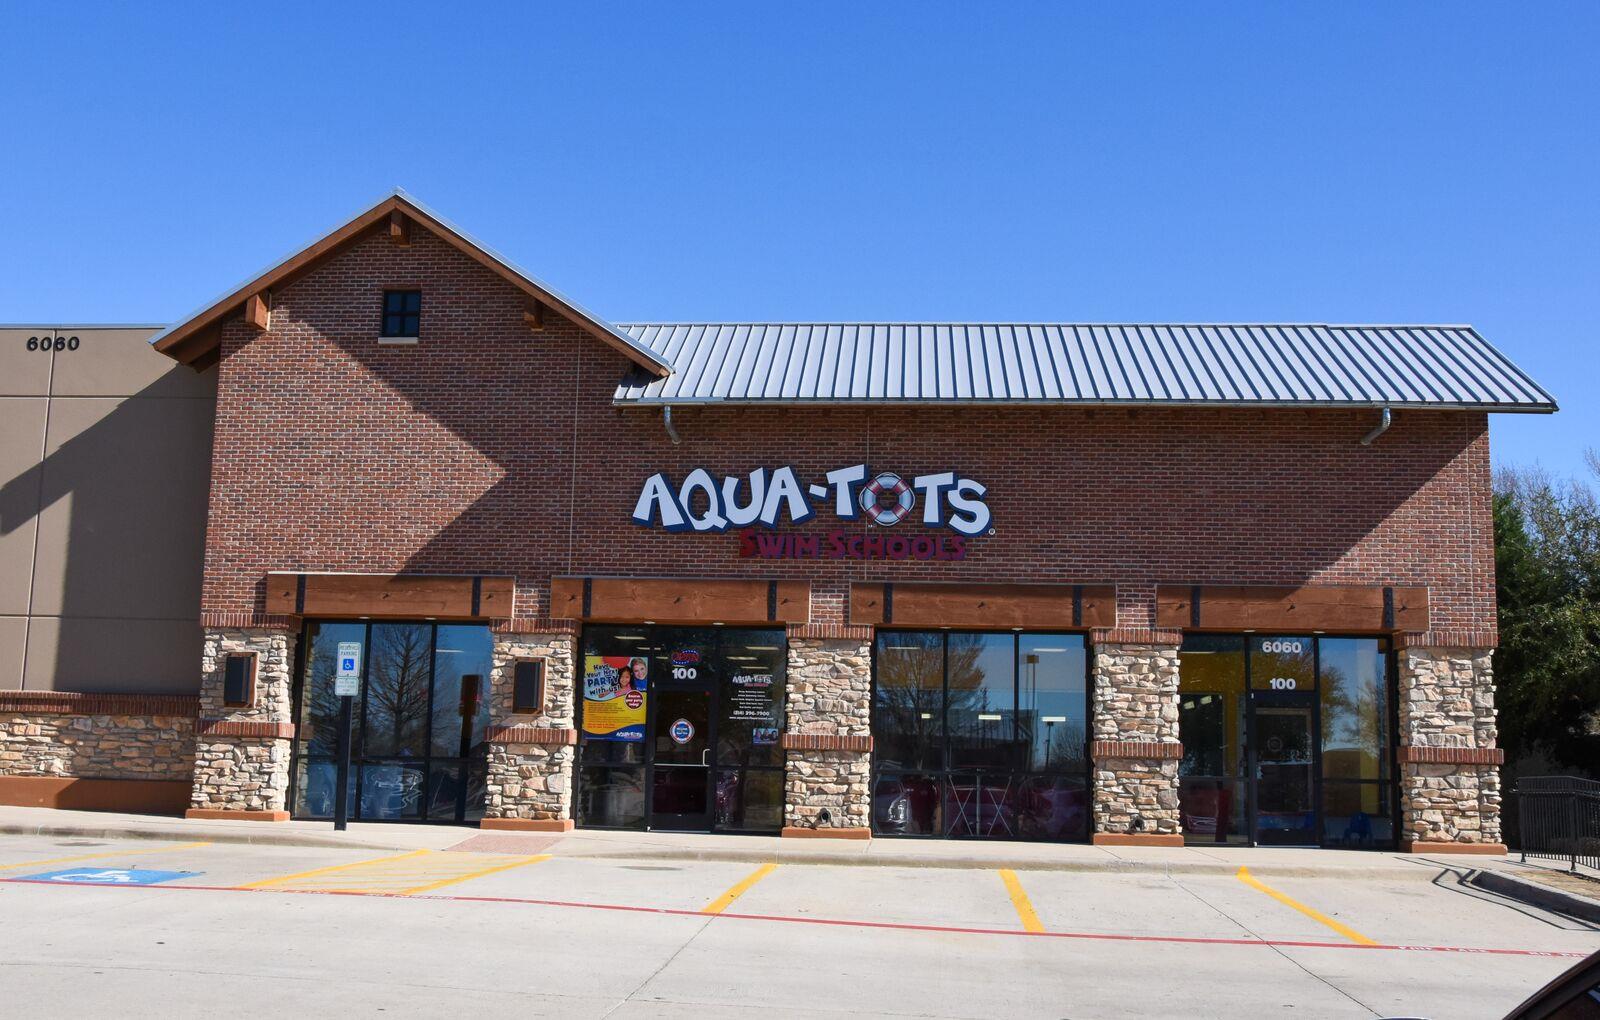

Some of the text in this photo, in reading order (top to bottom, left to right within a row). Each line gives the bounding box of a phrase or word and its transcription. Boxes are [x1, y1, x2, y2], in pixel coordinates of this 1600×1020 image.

[26, 336, 80, 352] 6060
[632, 464, 993, 537] AQUA-TOTS
[1262, 641, 1302, 653] 6060
[672, 668, 697, 679] 100
[587, 676, 619, 687] PARTY
[1269, 678, 1296, 690] 100
[590, 686, 606, 695] with
